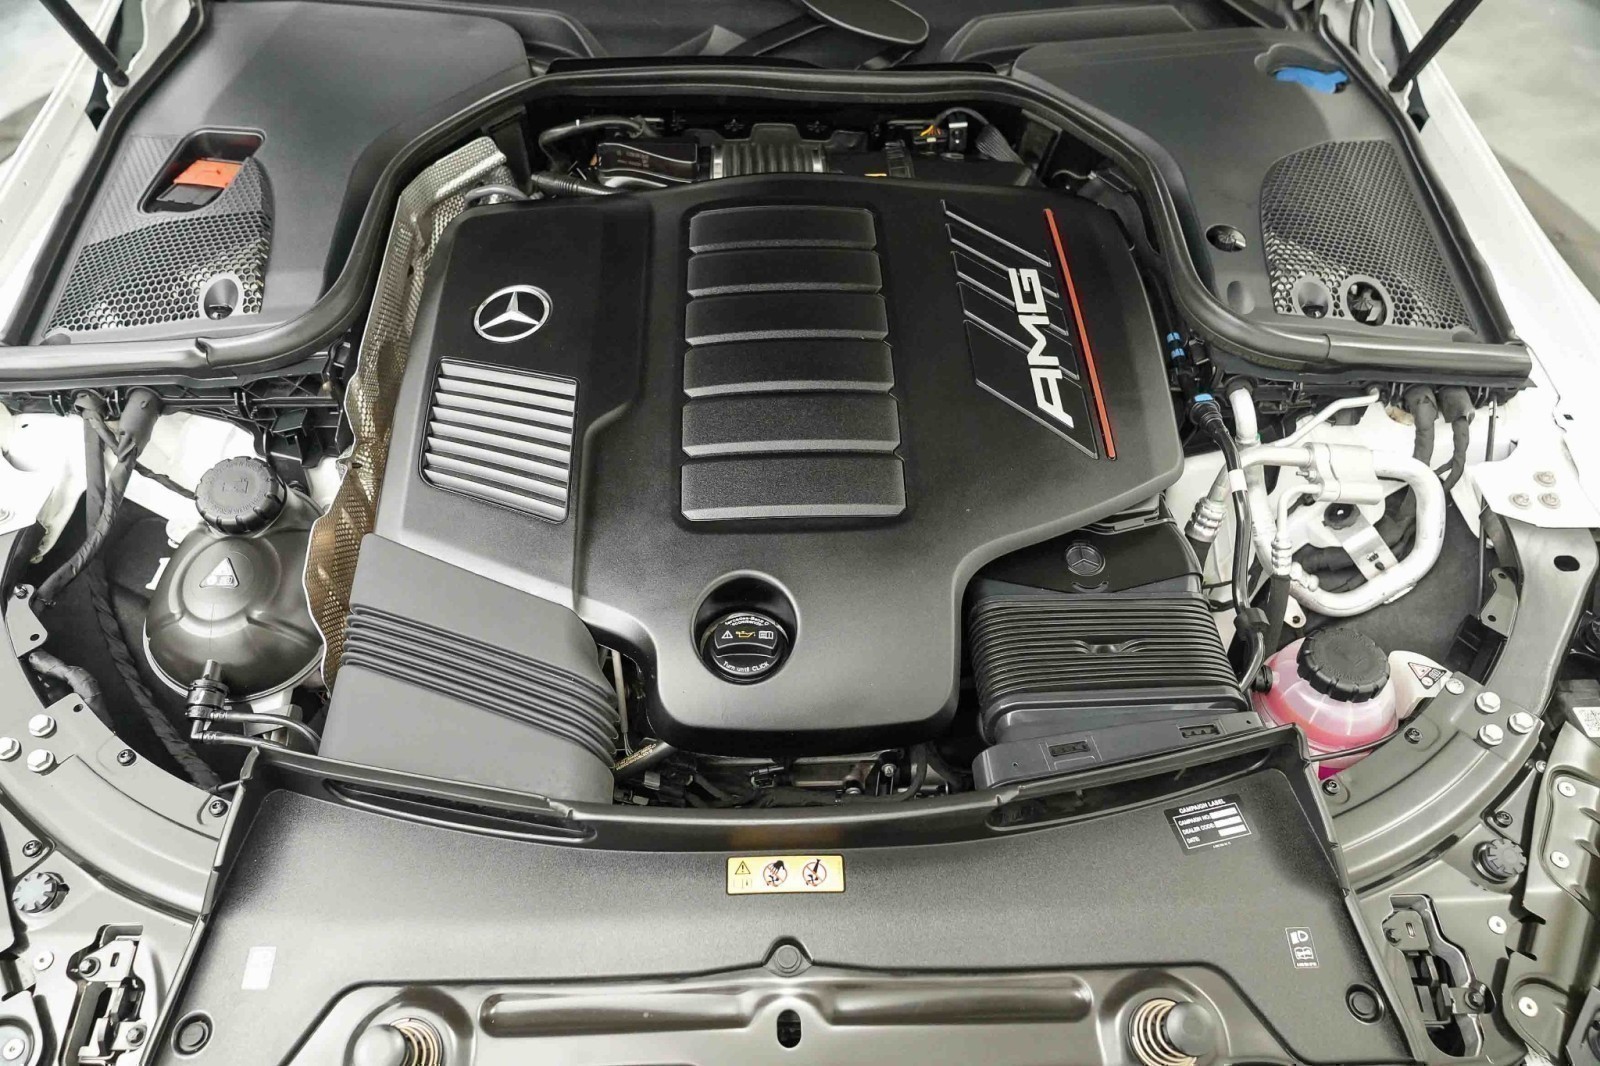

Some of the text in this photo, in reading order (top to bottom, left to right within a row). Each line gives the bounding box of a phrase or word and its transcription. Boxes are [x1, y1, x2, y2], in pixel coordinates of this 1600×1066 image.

[1008, 268, 1075, 428] AMG
[723, 660, 736, 671] Turn
[751, 661, 770, 672] CLICK
[1178, 798, 1226, 814] CAMPAIGN LABEL
